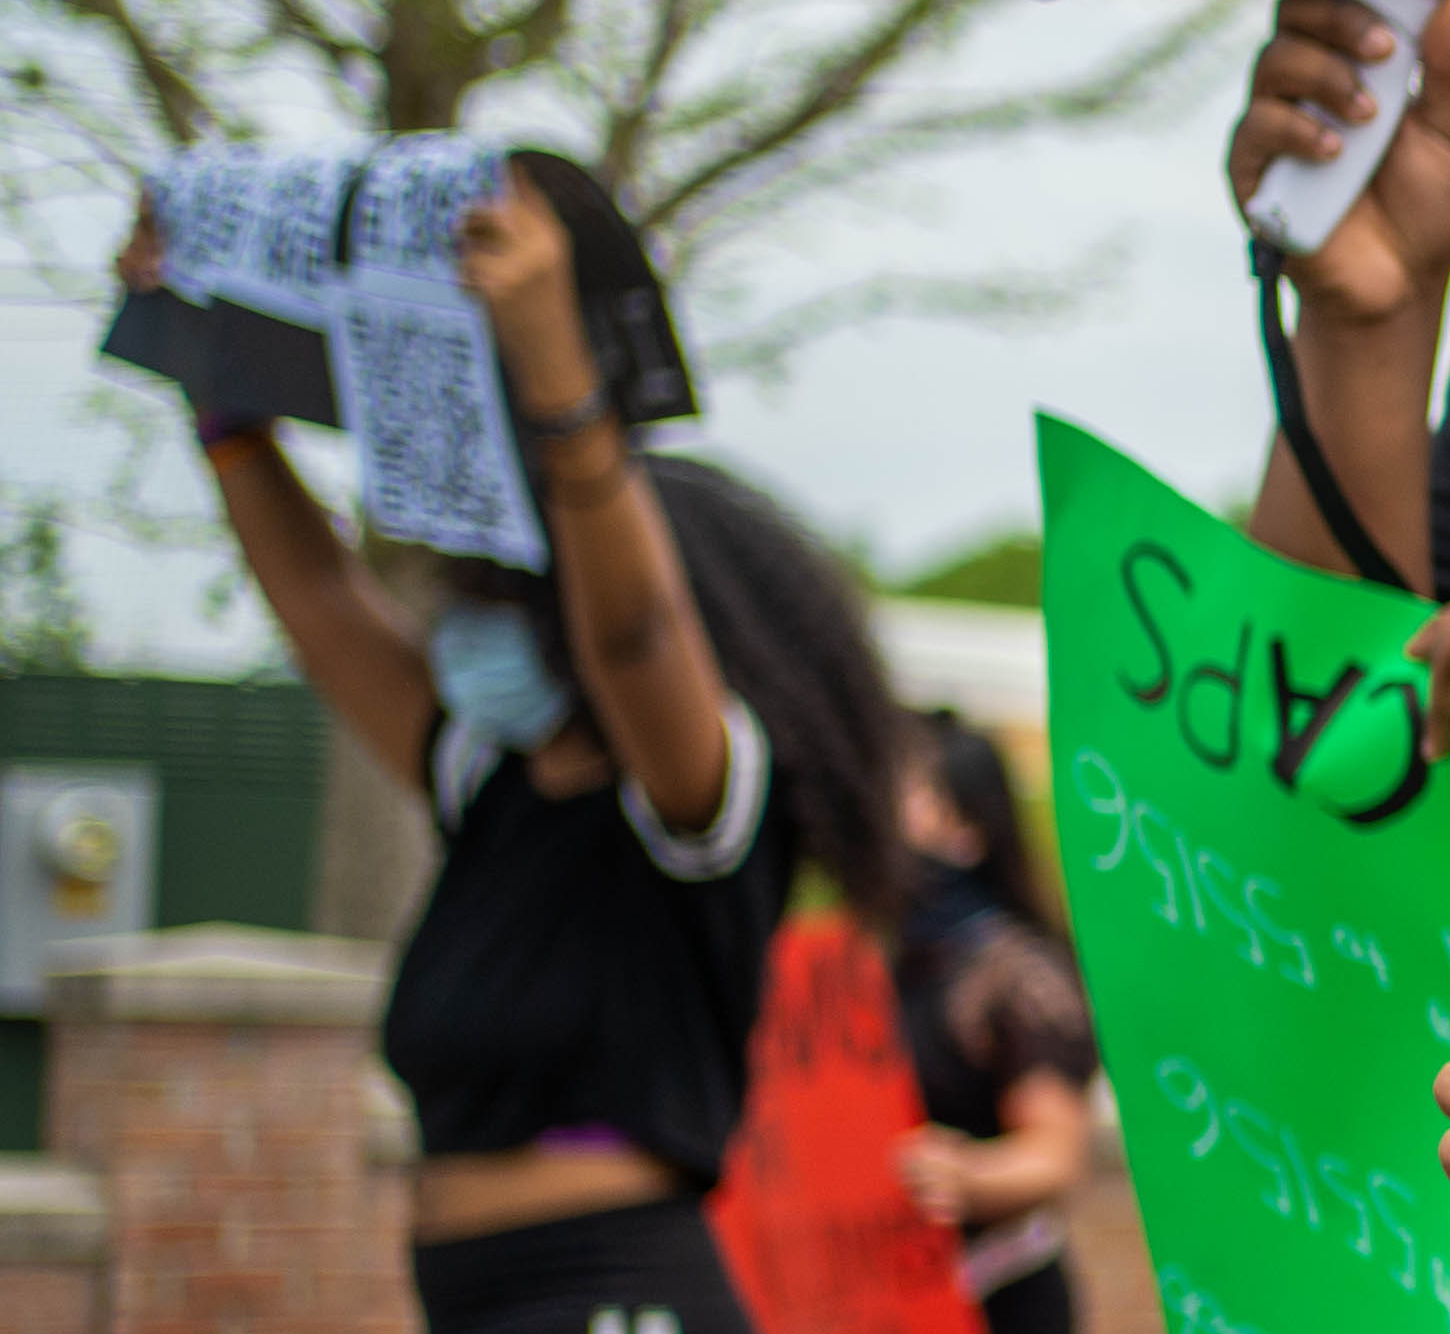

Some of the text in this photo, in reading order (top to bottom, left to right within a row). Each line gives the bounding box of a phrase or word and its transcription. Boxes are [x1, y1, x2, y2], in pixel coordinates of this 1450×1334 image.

[1116, 535, 1432, 829] CAPS
[1072, 747, 1319, 992] 55156
[1153, 1054, 1418, 1298] 55156
